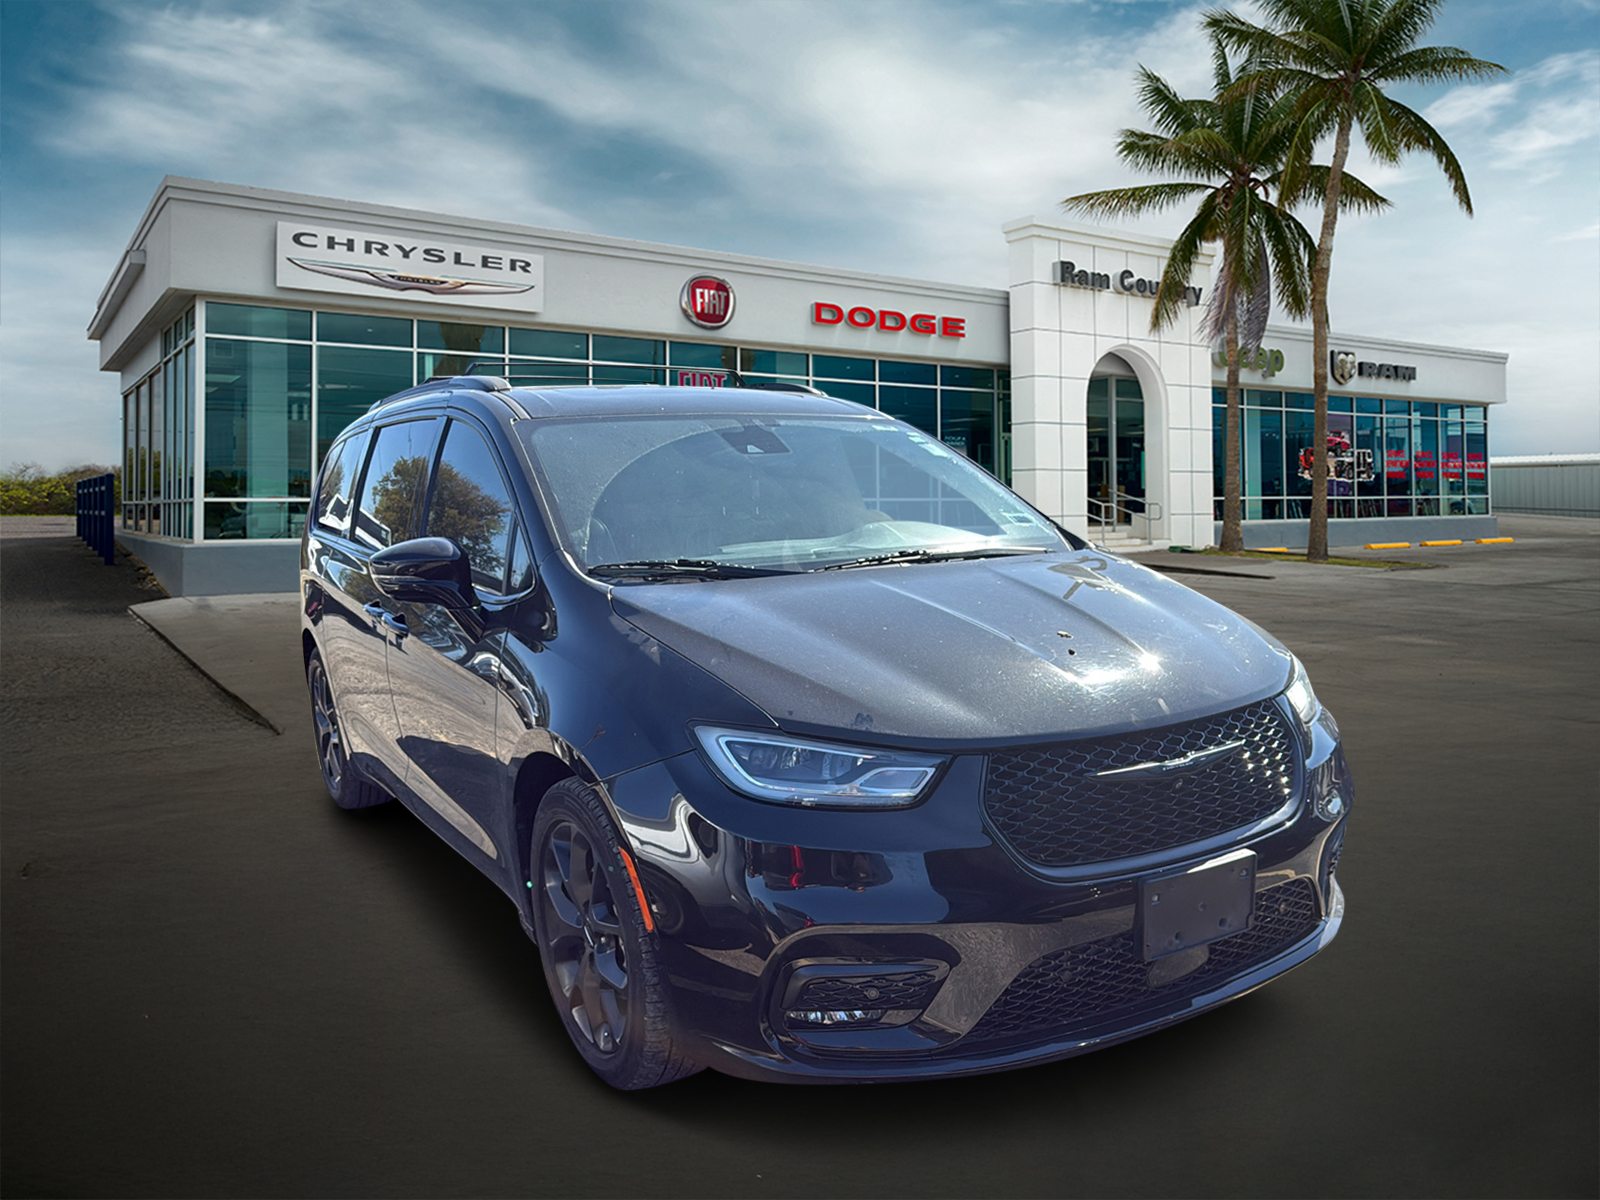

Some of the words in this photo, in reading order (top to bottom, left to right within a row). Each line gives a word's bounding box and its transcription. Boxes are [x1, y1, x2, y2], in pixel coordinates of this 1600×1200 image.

[292, 232, 532, 274] CHRYSLER
[1054, 260, 1110, 290] Ram
[695, 288, 727, 316] FIAT
[812, 301, 966, 339] DODGE
[1358, 362, 1416, 380] RAM
